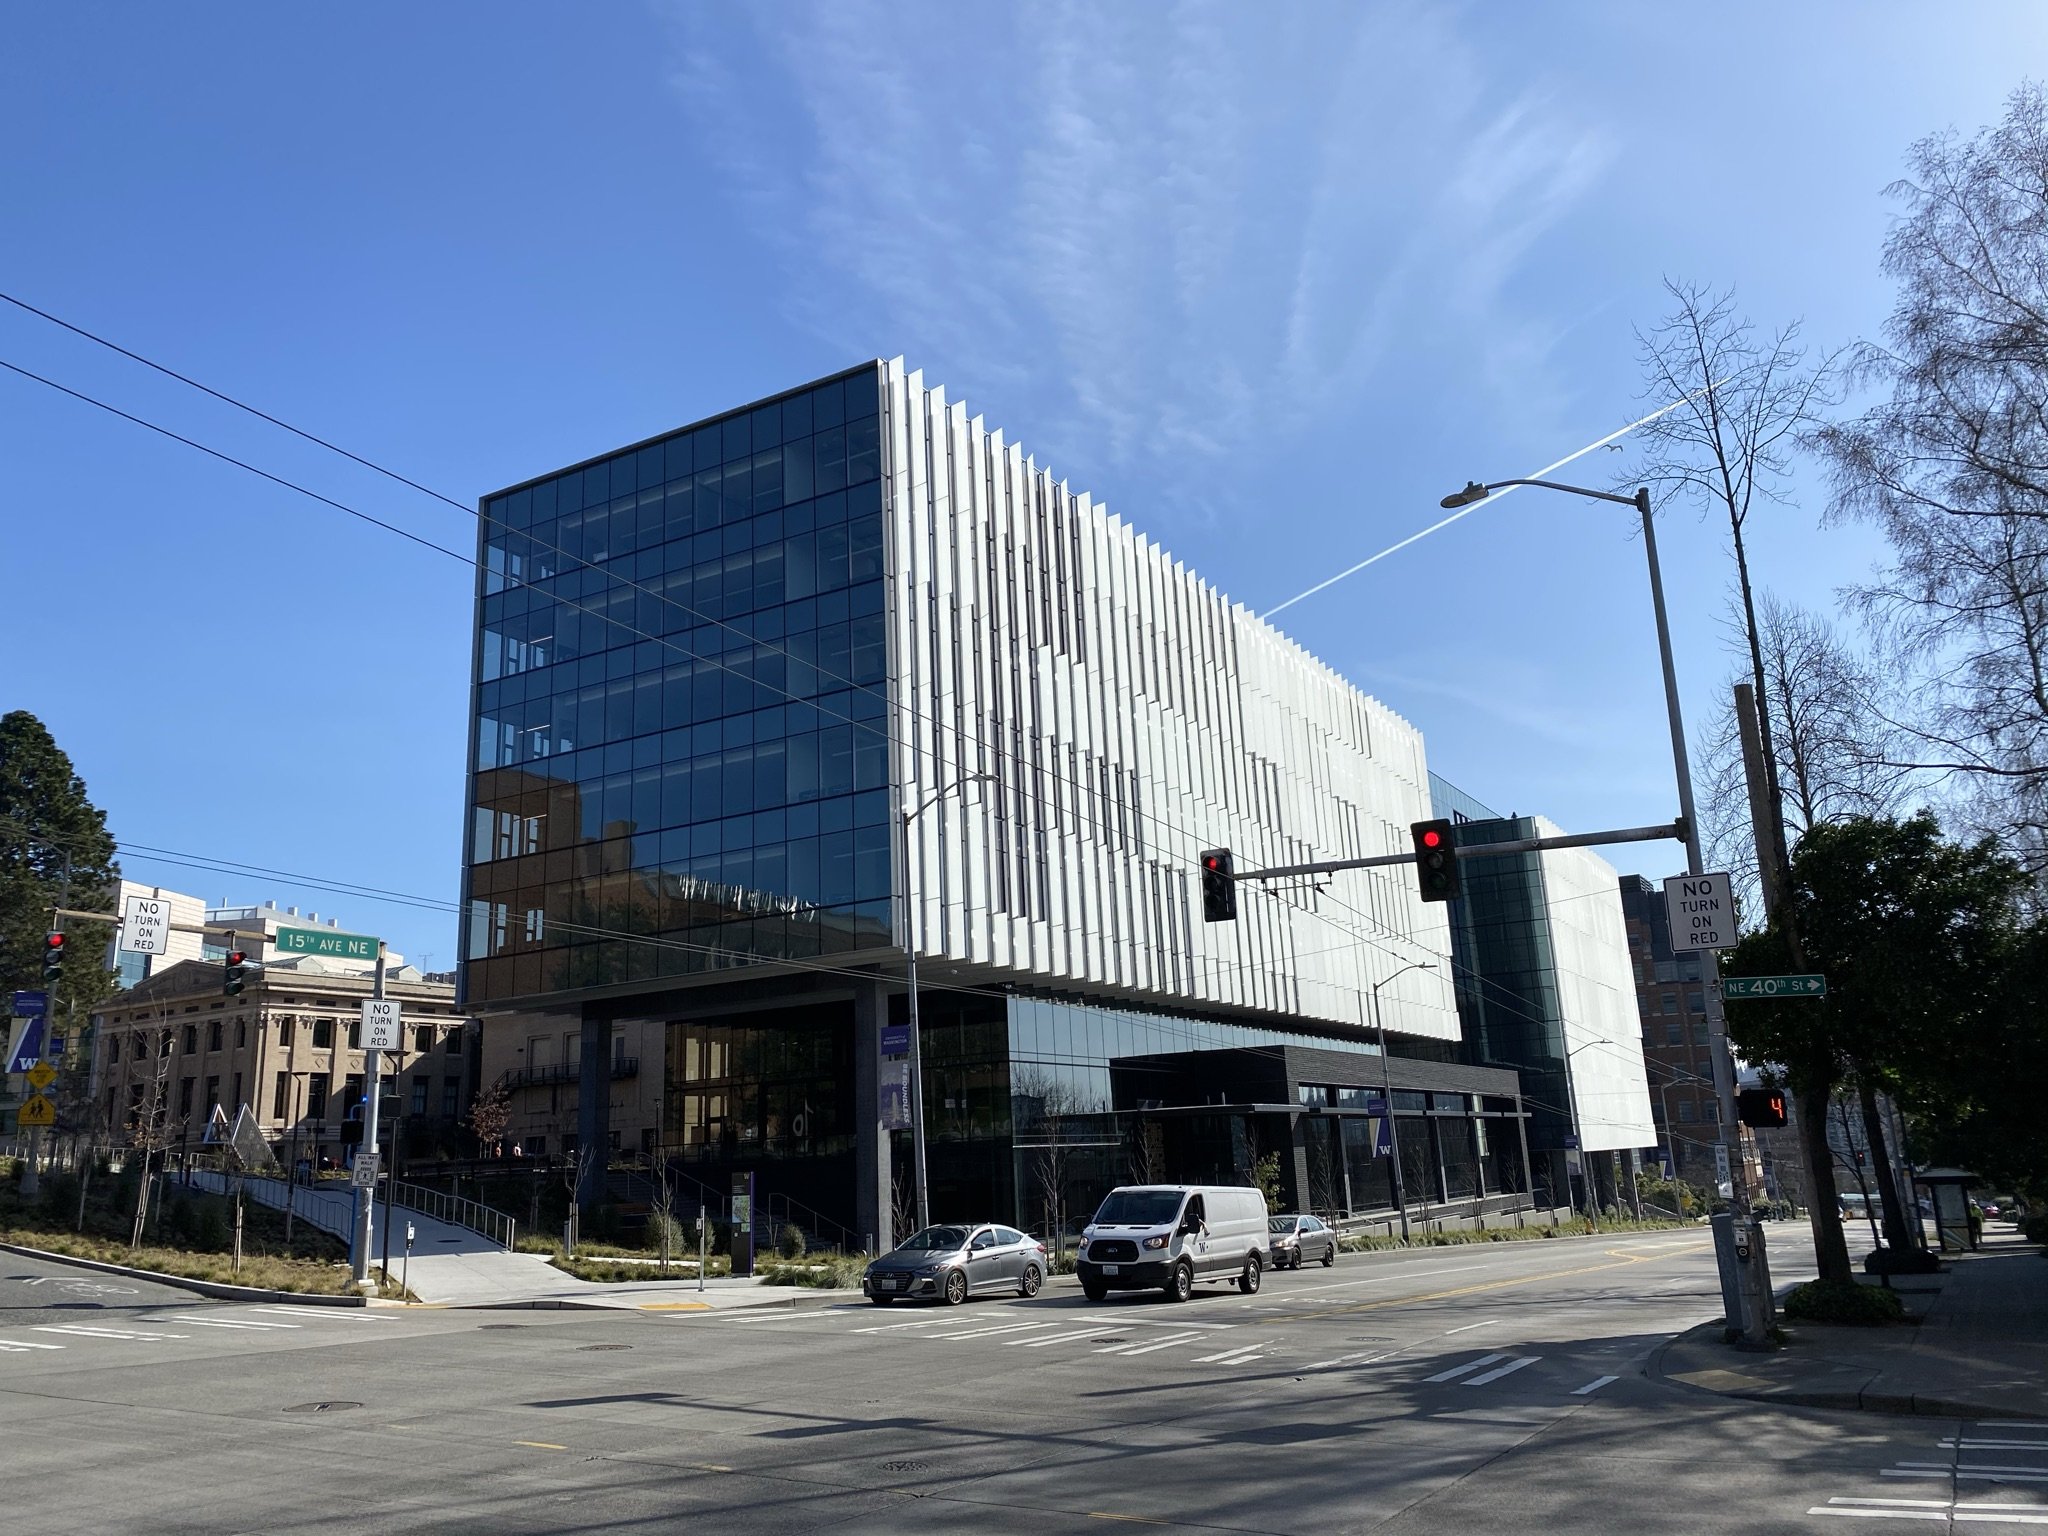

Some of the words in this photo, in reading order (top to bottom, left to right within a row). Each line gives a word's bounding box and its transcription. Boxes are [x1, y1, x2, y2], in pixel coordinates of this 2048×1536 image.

[1682, 880, 1712, 897] NO
[139, 901, 159, 914] NO
[1680, 898, 1719, 913] TURN
[134, 915, 161, 927] TURN
[1692, 915, 1712, 928] ON
[138, 927, 153, 938] ON
[1690, 931, 1719, 945] RED
[133, 939, 154, 950] RED
[288, 934, 315, 948] 15TH
[319, 938, 342, 952] AVE
[348, 940, 369, 954] NE
[1729, 982, 1746, 993] NE
[1750, 979, 1786, 994] 40th
[1791, 980, 1804, 991] St
[373, 1004, 391, 1015] NO
[370, 1016, 392, 1025] TURN
[374, 1027, 386, 1036] ON
[370, 1037, 388, 1046] RED
[19, 1058, 38, 1070] W
[901, 1074, 910, 1124] BOUNDLESS
[1771, 1098, 1783, 1119] 4
[1378, 1145, 1391, 1155] W
[1199, 1241, 1206, 1253] W
